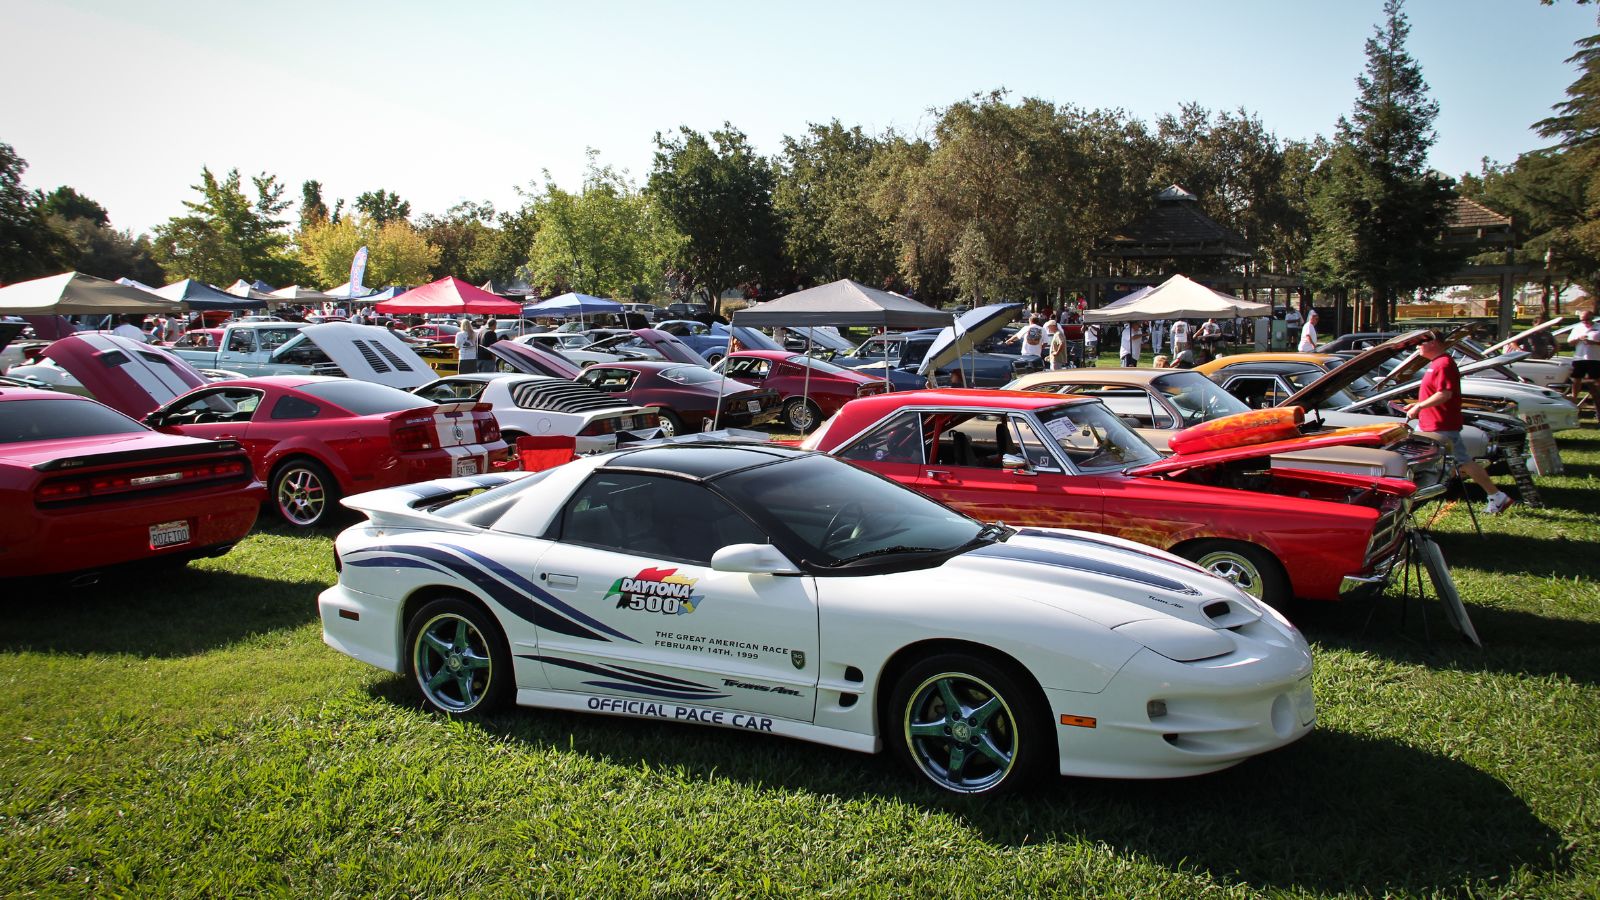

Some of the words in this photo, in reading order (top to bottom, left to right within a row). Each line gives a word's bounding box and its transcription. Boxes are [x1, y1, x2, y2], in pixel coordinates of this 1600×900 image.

[620, 578, 691, 598] DAYTONA
[629, 594, 681, 615] 500
[655, 631, 674, 639] THE
[676, 633, 707, 643] GREAT
[709, 638, 759, 650] AMERICAN
[762, 645, 789, 655] RACE
[655, 640, 704, 652] FEBRUARY
[707, 647, 733, 657] 14TH,
[737, 651, 759, 660] 1999
[721, 678, 770, 693] Trans
[769, 686, 805, 698] Am
[587, 697, 668, 718] OFFICIAL
[675, 706, 724, 725] PACE
[732, 714, 773, 733] CAR
